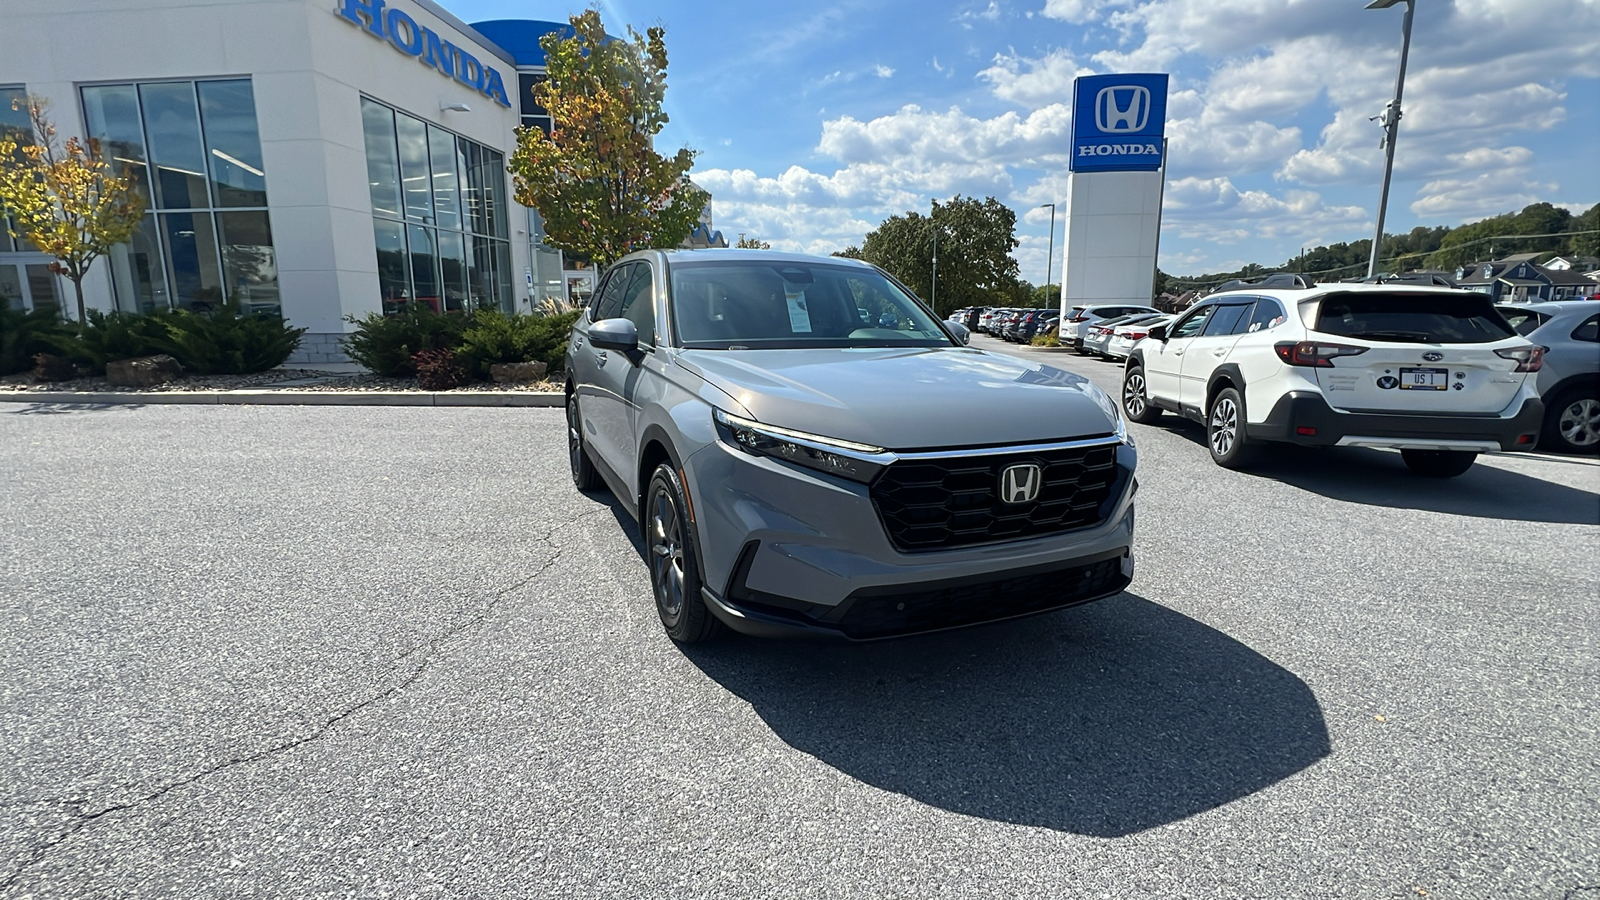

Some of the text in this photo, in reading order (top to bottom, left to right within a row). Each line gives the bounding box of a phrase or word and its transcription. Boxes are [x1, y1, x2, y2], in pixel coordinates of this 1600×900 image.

[334, 0, 511, 108] HONDA
[1078, 143, 1160, 157] HONDA
[1414, 373, 1426, 385] US
